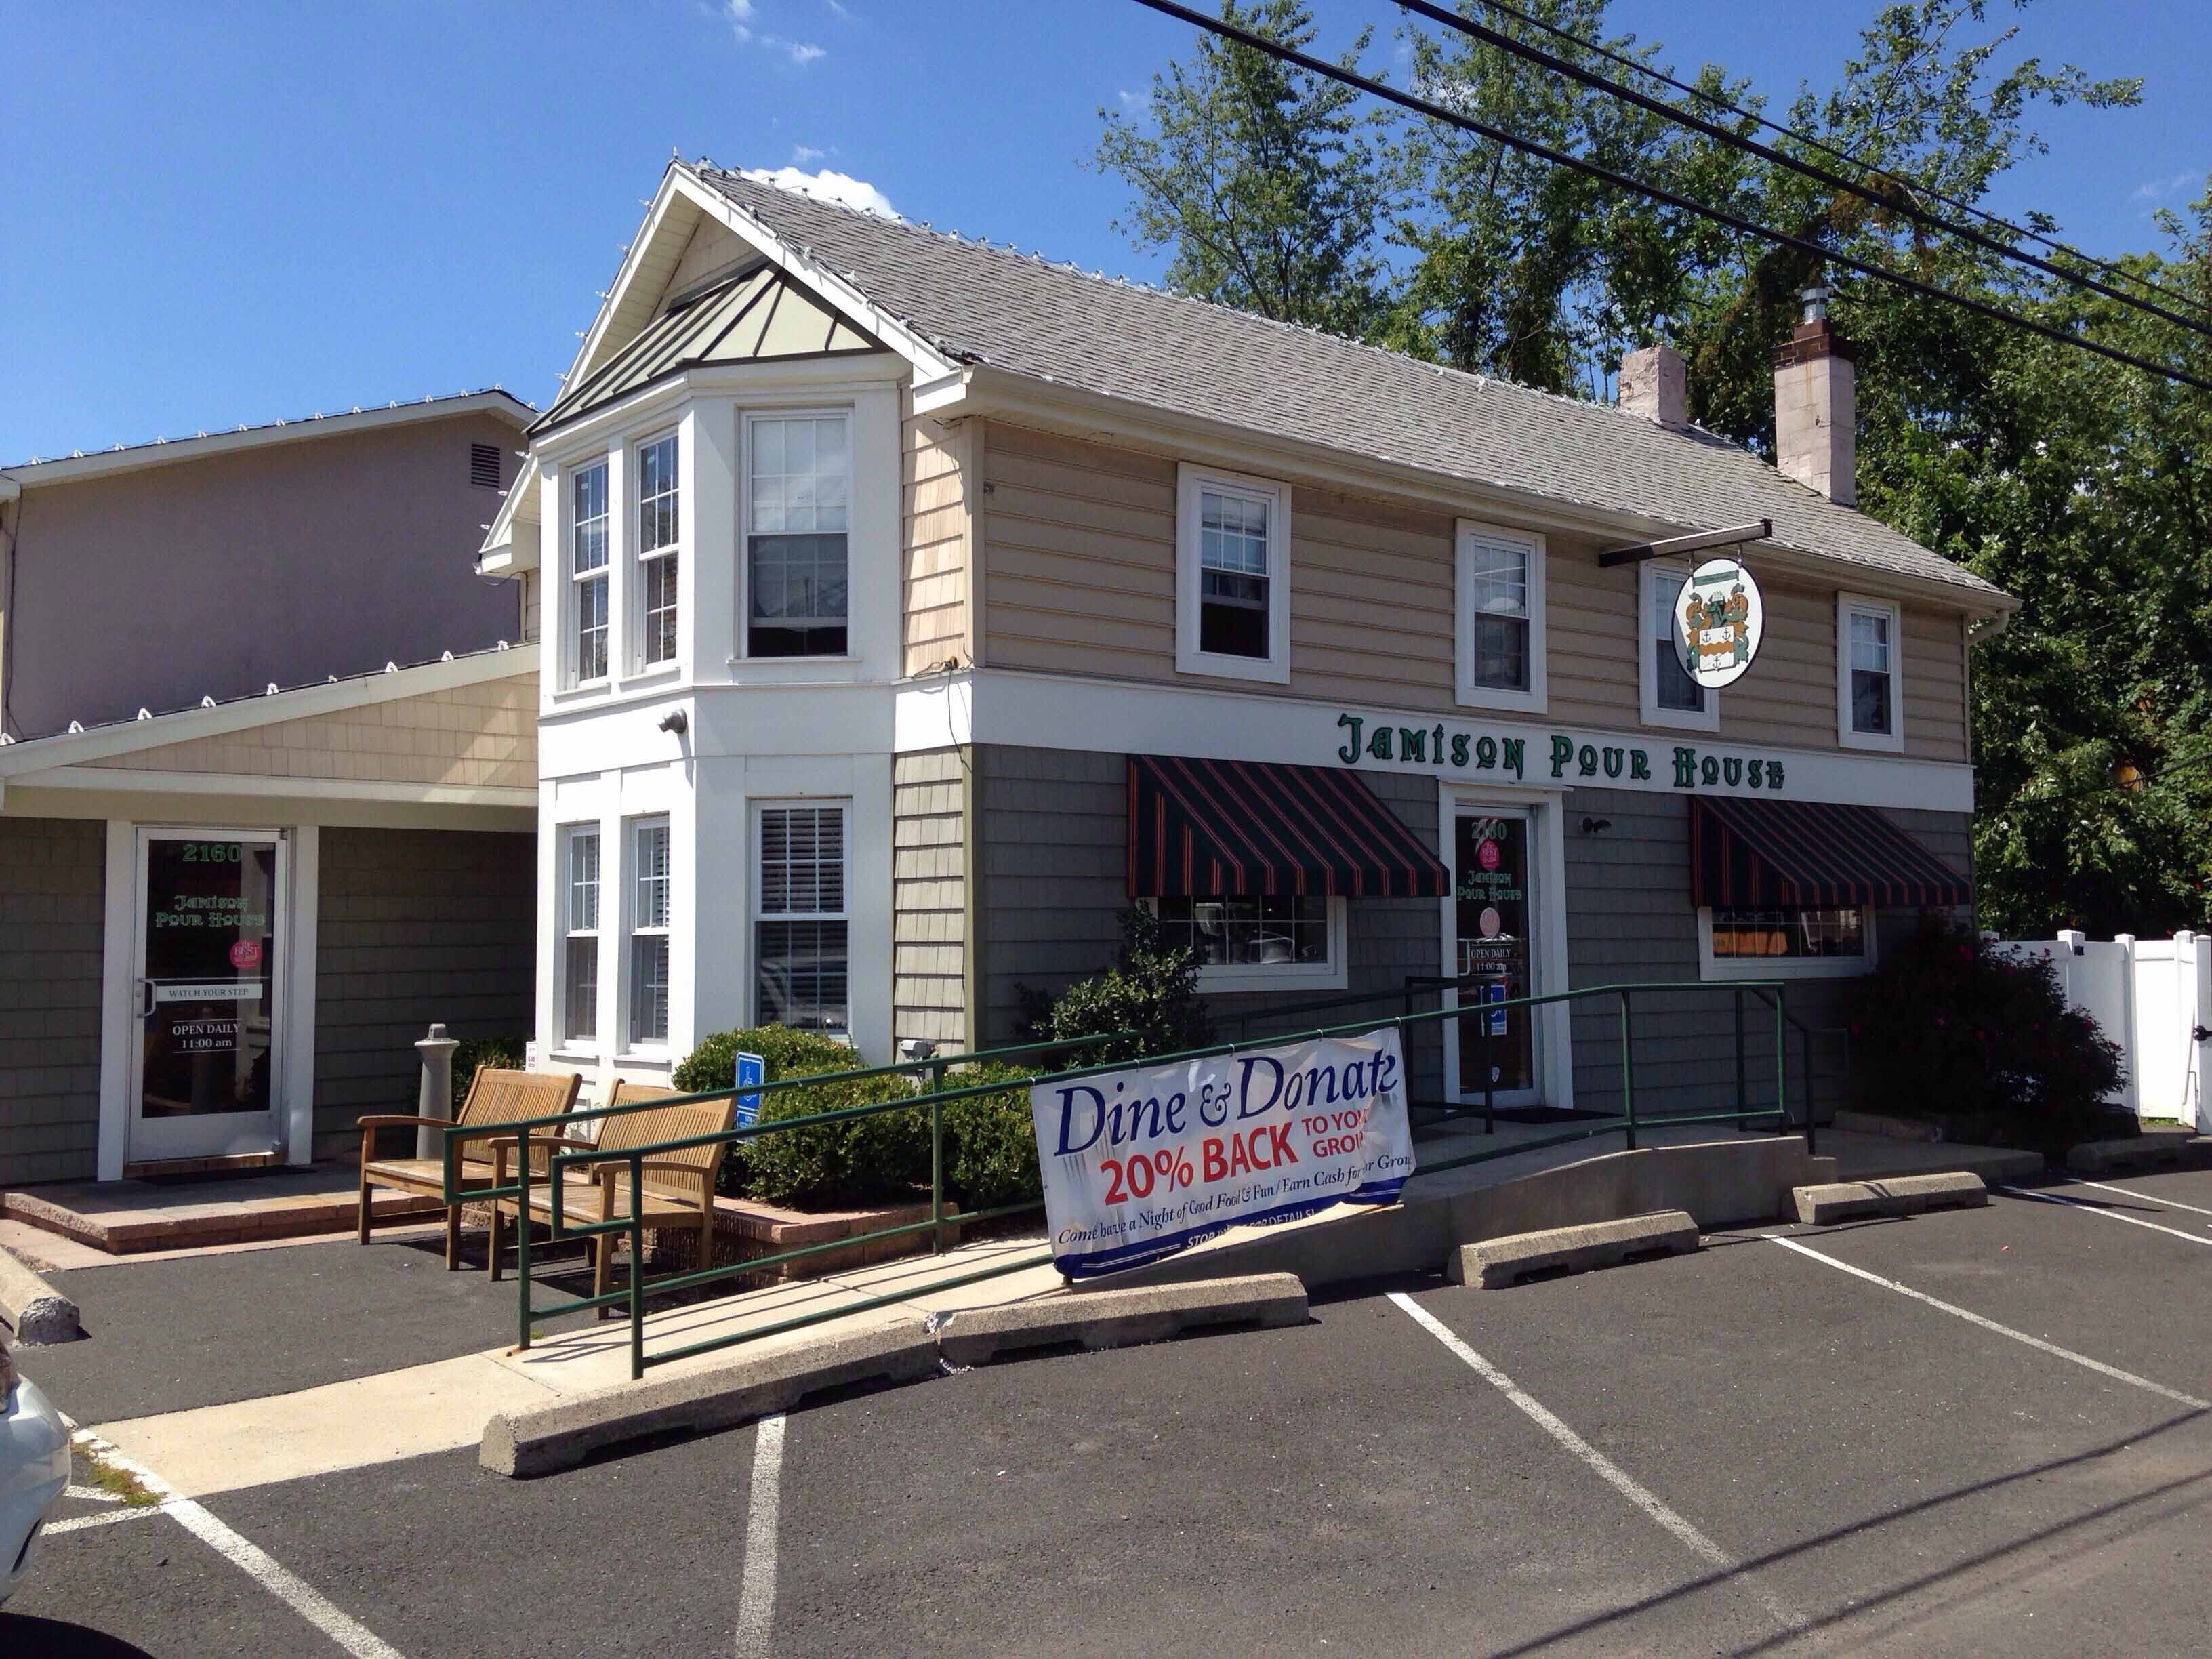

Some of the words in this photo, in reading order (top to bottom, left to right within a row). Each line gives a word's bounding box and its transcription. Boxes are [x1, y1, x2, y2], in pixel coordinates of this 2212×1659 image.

[1551, 735, 1652, 780] POUR
[1673, 747, 1784, 788] HOUSE
[183, 844, 242, 863] 2160
[155, 912, 203, 928] POUR
[1471, 949, 1489, 958] OPEN
[1491, 949, 1511, 958] DAILY
[169, 989, 201, 998] WATCH
[173, 1025, 204, 1036] OPEN
[207, 1023, 239, 1034] DAILY
[182, 1038, 213, 1048] 11:00
[216, 1039, 232, 1047] am
[1054, 1082, 1186, 1157] Dine
[1200, 1083, 1231, 1128] &
[1237, 1048, 1398, 1120] Donate
[1301, 1115, 1328, 1136] TO
[1100, 1145, 1193, 1206] 20%
[1202, 1122, 1298, 1183] BACK
[1059, 1228, 1097, 1244] Come
[1100, 1221, 1126, 1237] have
[1128, 1219, 1136, 1231] a
[1139, 1207, 1176, 1231] Night
[1176, 1200, 1188, 1224] of
[1216, 1189, 1241, 1209] Food
[1242, 1187, 1251, 1203] &
[1253, 1184, 1274, 1200] Fun
[1283, 1177, 1310, 1193] Earn
[1314, 1168, 1345, 1186] Cash
[1344, 1166, 1361, 1187] for
[1378, 1155, 1411, 1170] Grou
